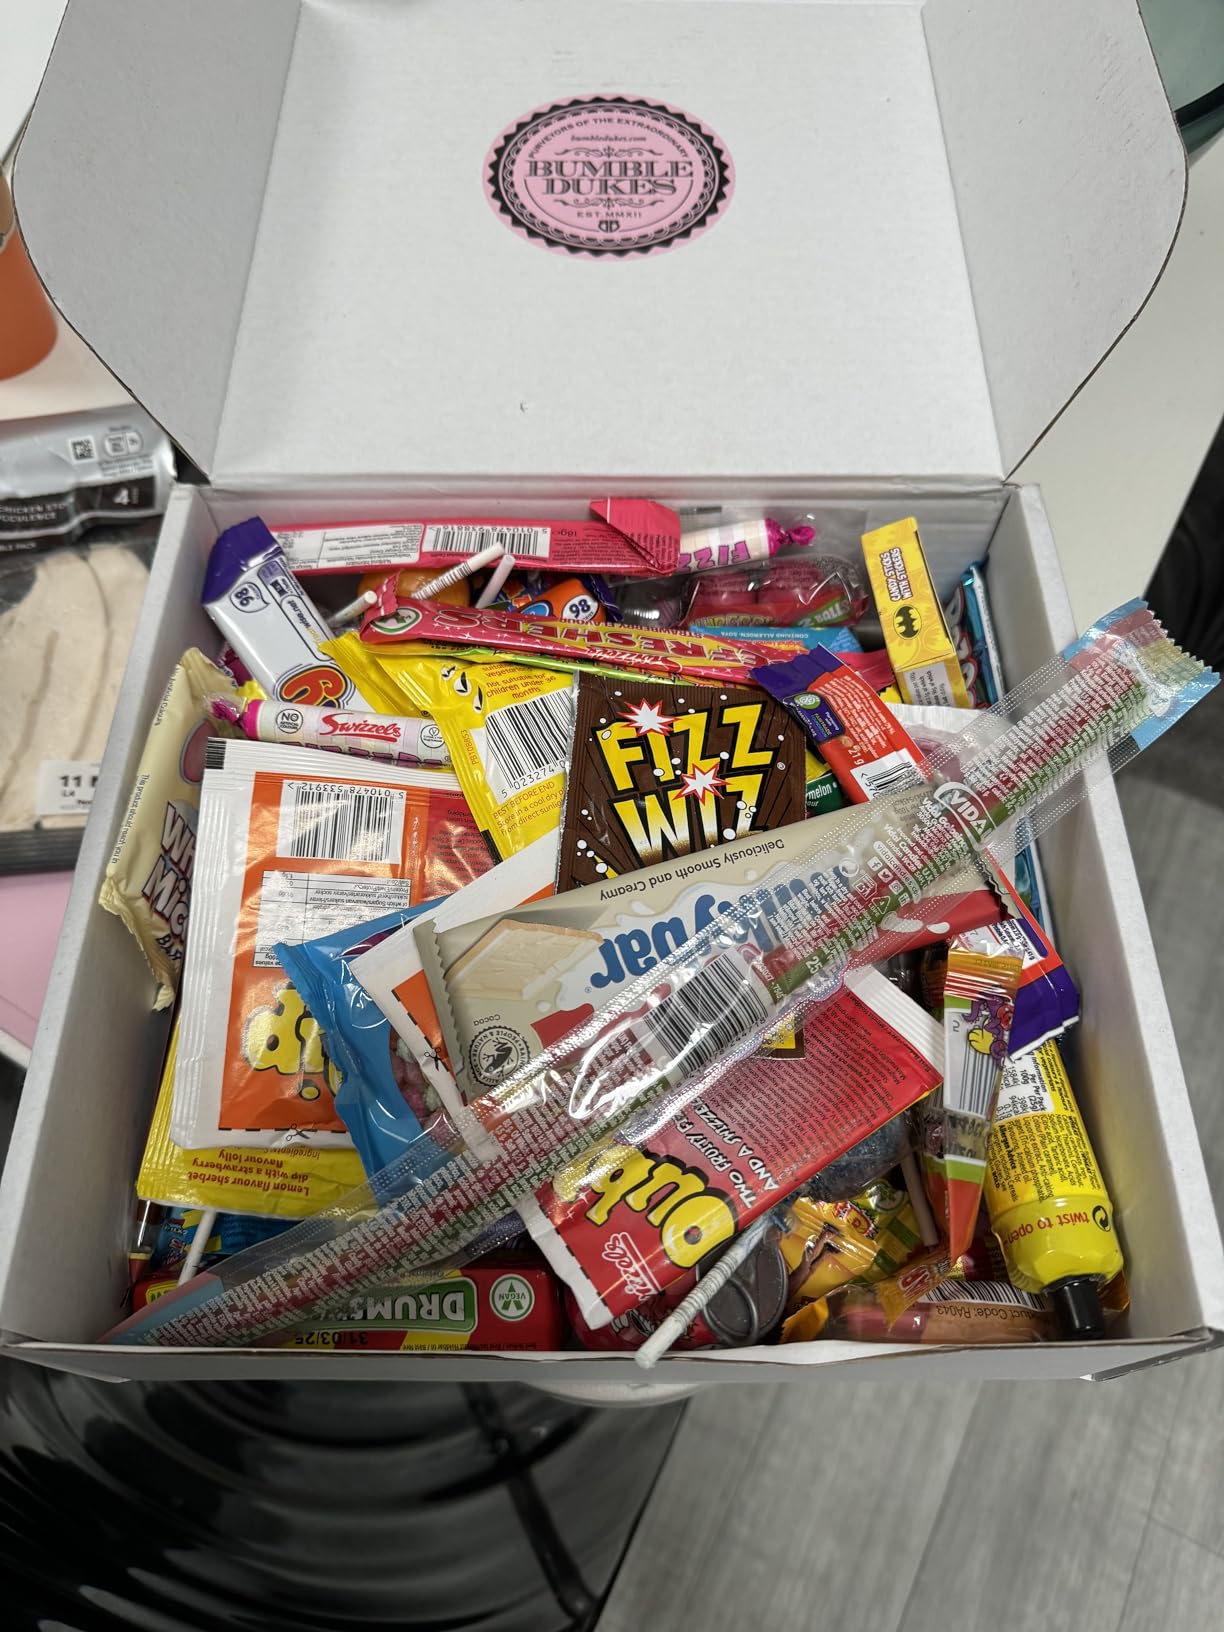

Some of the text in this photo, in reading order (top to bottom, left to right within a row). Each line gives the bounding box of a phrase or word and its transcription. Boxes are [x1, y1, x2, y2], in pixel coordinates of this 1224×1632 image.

[570, 133, 647, 143] bumbledukes.com
[616, 117, 689, 158] EXTRAORDINARY
[526, 160, 694, 178] BUMBLE
[543, 178, 677, 195] DUKES
[233, 586, 250, 607] 98
[569, 598, 592, 617] 98
[486, 681, 544, 698] children under
[512, 688, 543, 700] months
[281, 711, 299, 723] NO
[319, 713, 402, 743] Swizzels
[594, 702, 775, 793] FIZZ
[300, 782, 344, 793] 533912
[348, 786, 391, 797] 010478
[501, 789, 508, 798] 5
[514, 768, 555, 791] 023274
[131, 785, 144, 808] product
[492, 781, 556, 819] BEST BEFORE END
[529, 797, 546, 809] cool
[546, 792, 559, 805] dry
[611, 771, 767, 868] WIZ
[882, 823, 924, 869] Vidal Candies
[885, 838, 904, 857] London
[599, 838, 786, 901] Deliciously Smooth and Creamy
[803, 954, 824, 975] 25
[473, 1014, 501, 1027] Cocoa
[1030, 1055, 1047, 1092] Information
[1018, 1068, 1039, 1112] 100g (25g)
[1028, 1073, 1046, 1111] Per Per Pack
[1013, 1118, 1025, 1134] agent
[1031, 1114, 1044, 1133] Colour
[1061, 1113, 1073, 1132] Calcium
[734, 1142, 754, 1161] A
[998, 1124, 1011, 1150] Allergen
[1006, 1149, 1018, 1169] Advice
[1047, 1113, 1060, 1135] Sodium
[1066, 1170, 1077, 1186] Acids
[192, 1157, 254, 1175] strawberry
[218, 1149, 284, 1168] flavour lolly
[1016, 1151, 1029, 1174] Aniseed
[1022, 1116, 1037, 1142] Liquorice
[1038, 1163, 1054, 1198] Anti-caking
[264, 1167, 289, 1181] with
[291, 1171, 309, 1183] dip
[684, 1126, 759, 1209] TWO FRUITY
[745, 1154, 780, 1195] AND
[187, 1171, 309, 1197] Lemon flavour sherbet
[1006, 1179, 1019, 1201] Cereals
[1041, 1214, 1055, 1229] to
[1058, 1210, 1091, 1225] twist
[498, 1292, 527, 1301] VEGAN
[936, 1304, 1008, 1319] Code: RA043
